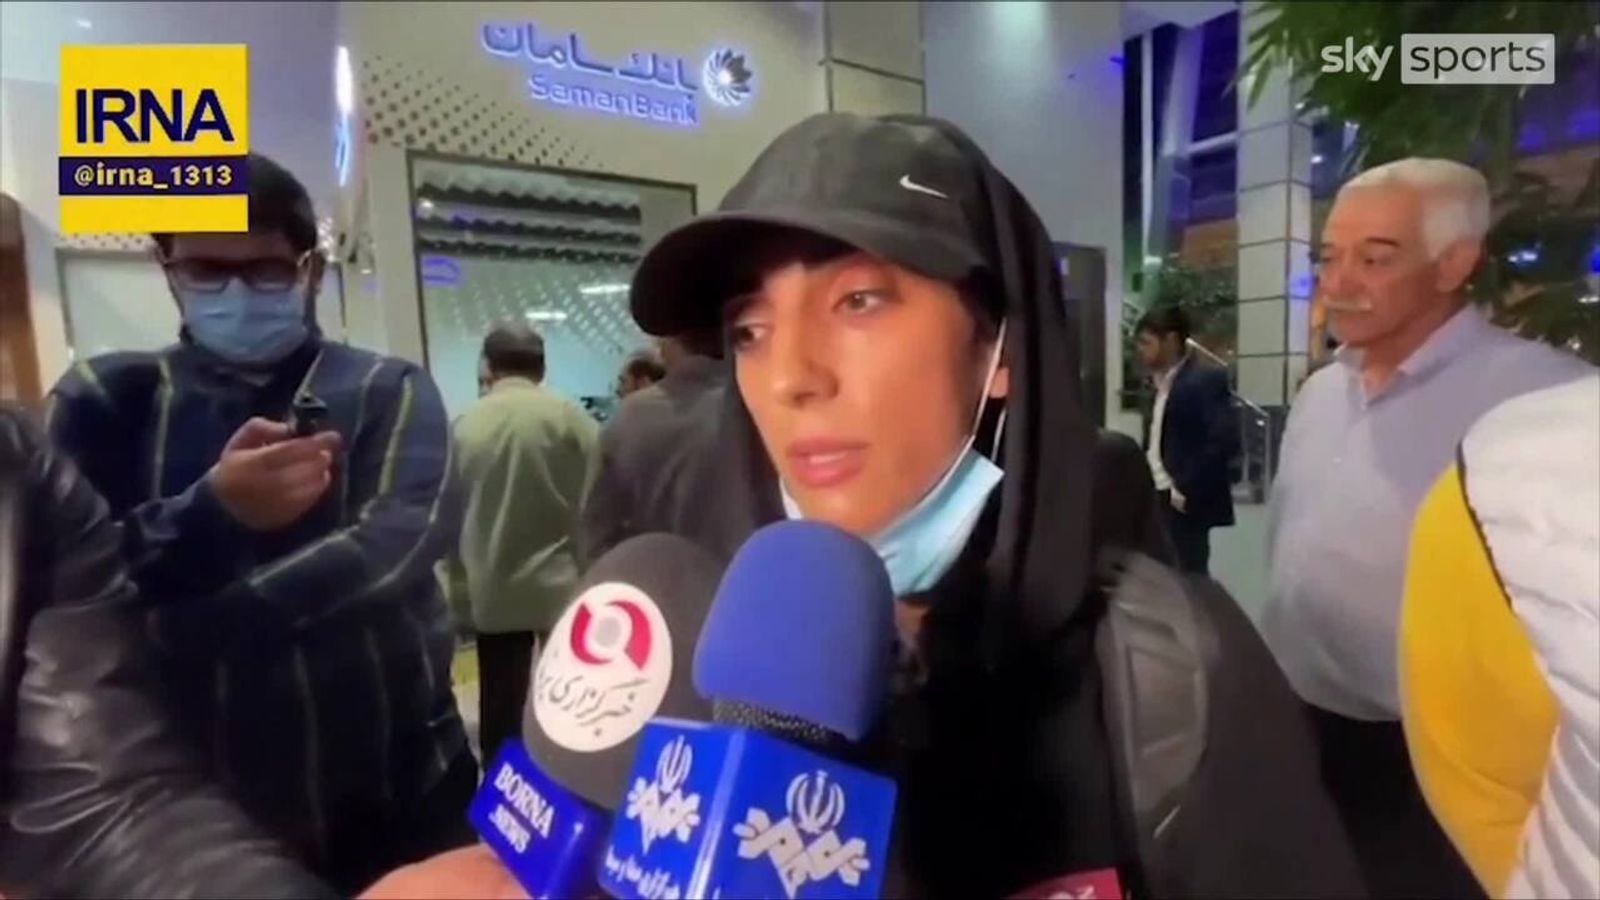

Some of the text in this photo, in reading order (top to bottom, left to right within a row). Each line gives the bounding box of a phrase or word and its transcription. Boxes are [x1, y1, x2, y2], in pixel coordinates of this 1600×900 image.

[482, 21, 615, 77] سامان
[493, 761, 555, 839] BORNA
[488, 803, 531, 854] NEWS
